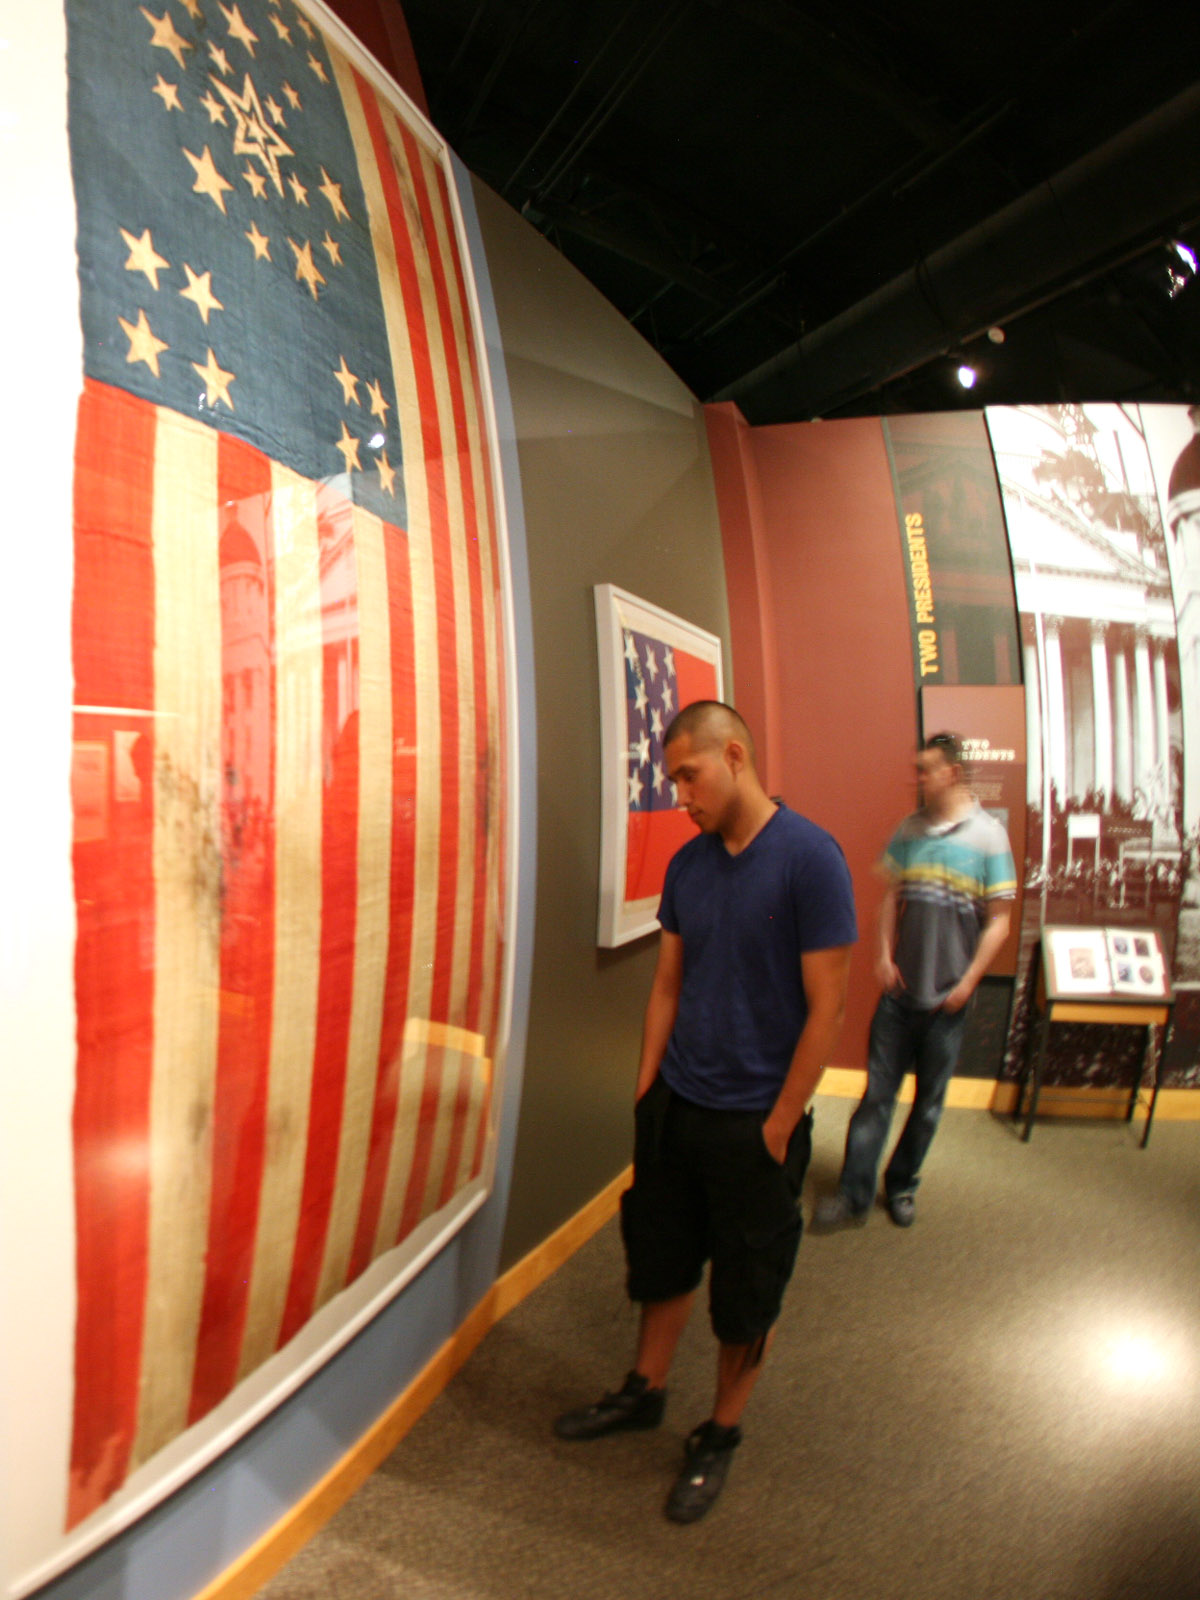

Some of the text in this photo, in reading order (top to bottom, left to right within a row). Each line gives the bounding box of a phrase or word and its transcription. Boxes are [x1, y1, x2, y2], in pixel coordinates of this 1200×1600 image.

[905, 512, 940, 677] TWO PRESIDENTS
[961, 738, 991, 751] TWO
[956, 749, 1016, 762] SIDENTS
